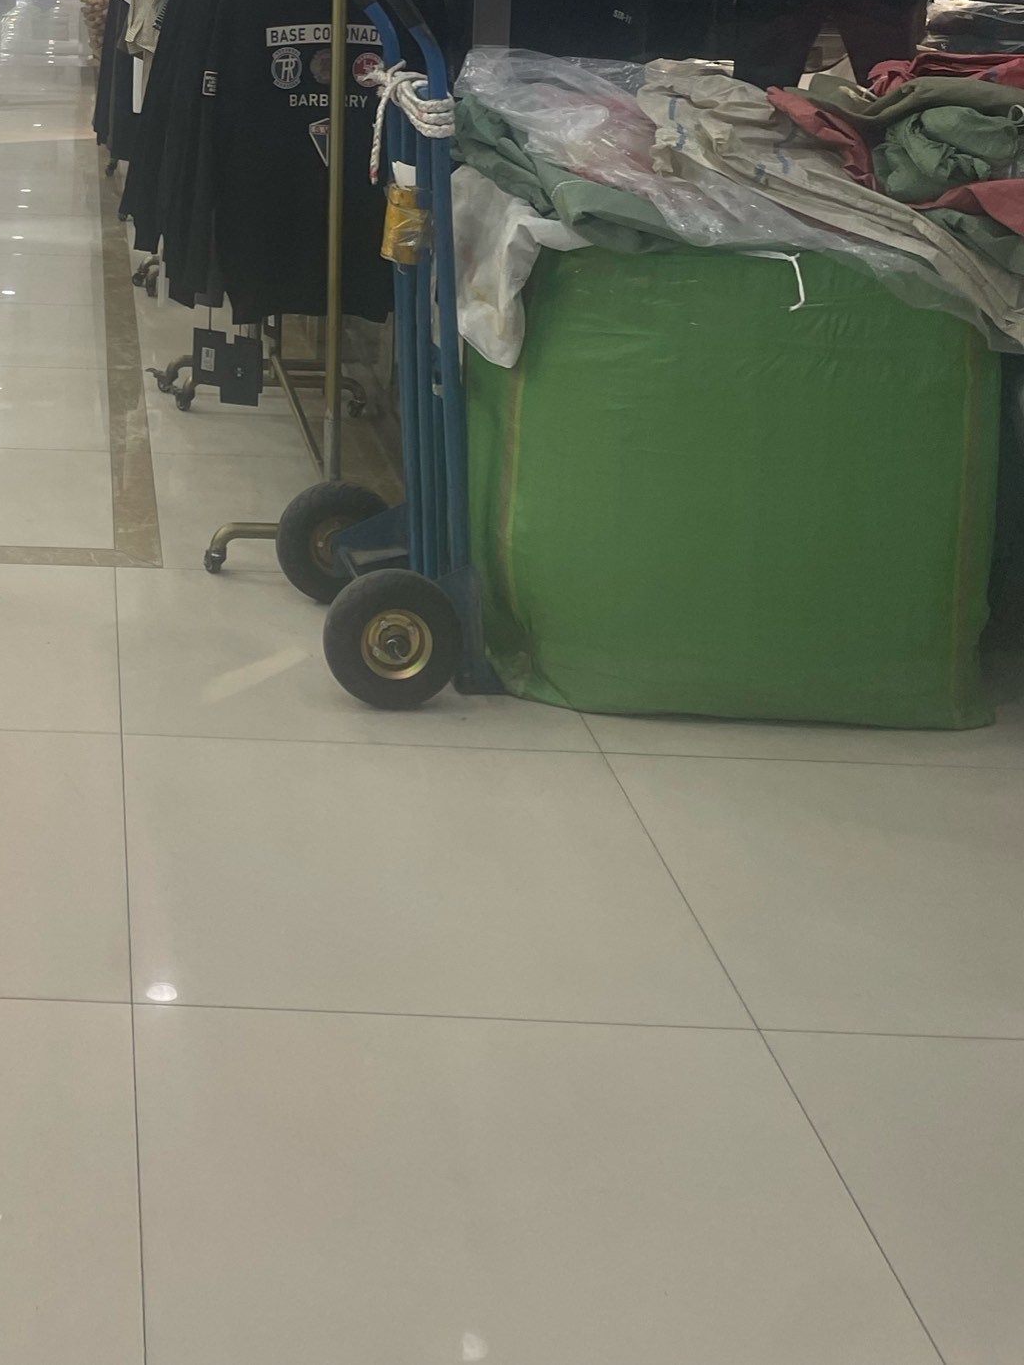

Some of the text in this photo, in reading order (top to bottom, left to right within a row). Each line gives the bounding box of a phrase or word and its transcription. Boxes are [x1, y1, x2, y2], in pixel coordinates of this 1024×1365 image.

[270, 27, 382, 44] BASE CONAD
[289, 94, 368, 108] BARBRY
